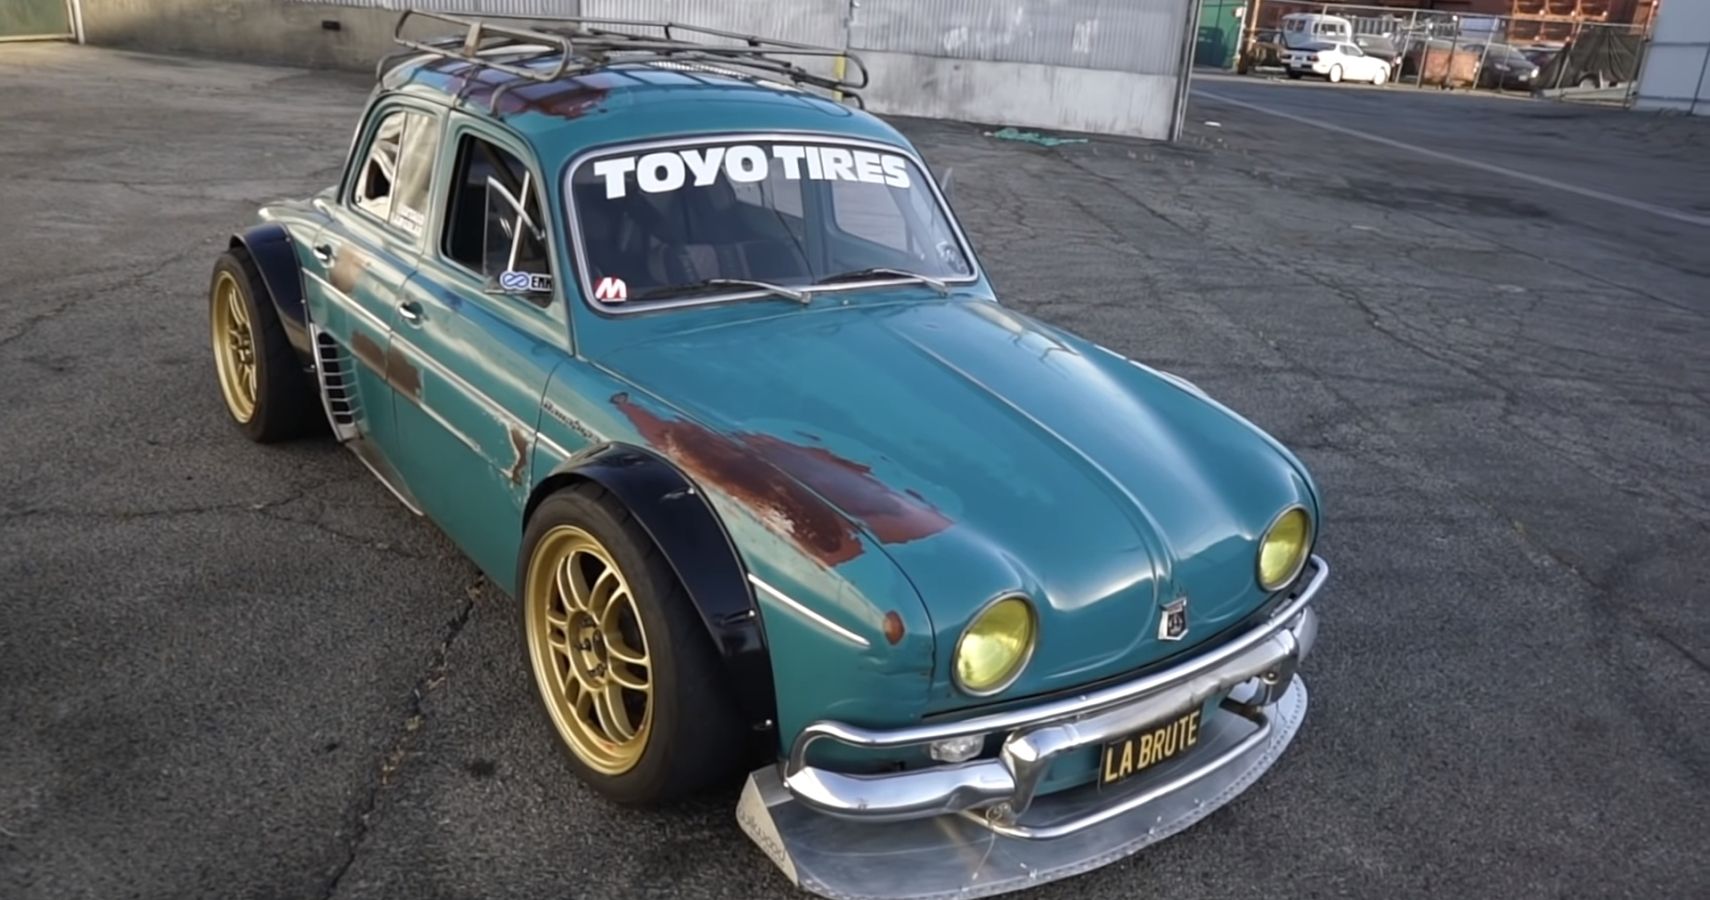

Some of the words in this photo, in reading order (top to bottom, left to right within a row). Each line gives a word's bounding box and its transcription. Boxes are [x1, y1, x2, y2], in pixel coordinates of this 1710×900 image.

[594, 145, 769, 199] TOYO
[772, 145, 910, 188] TIRES
[1105, 740, 1132, 782] LA
[1137, 710, 1199, 769] BRUTE
